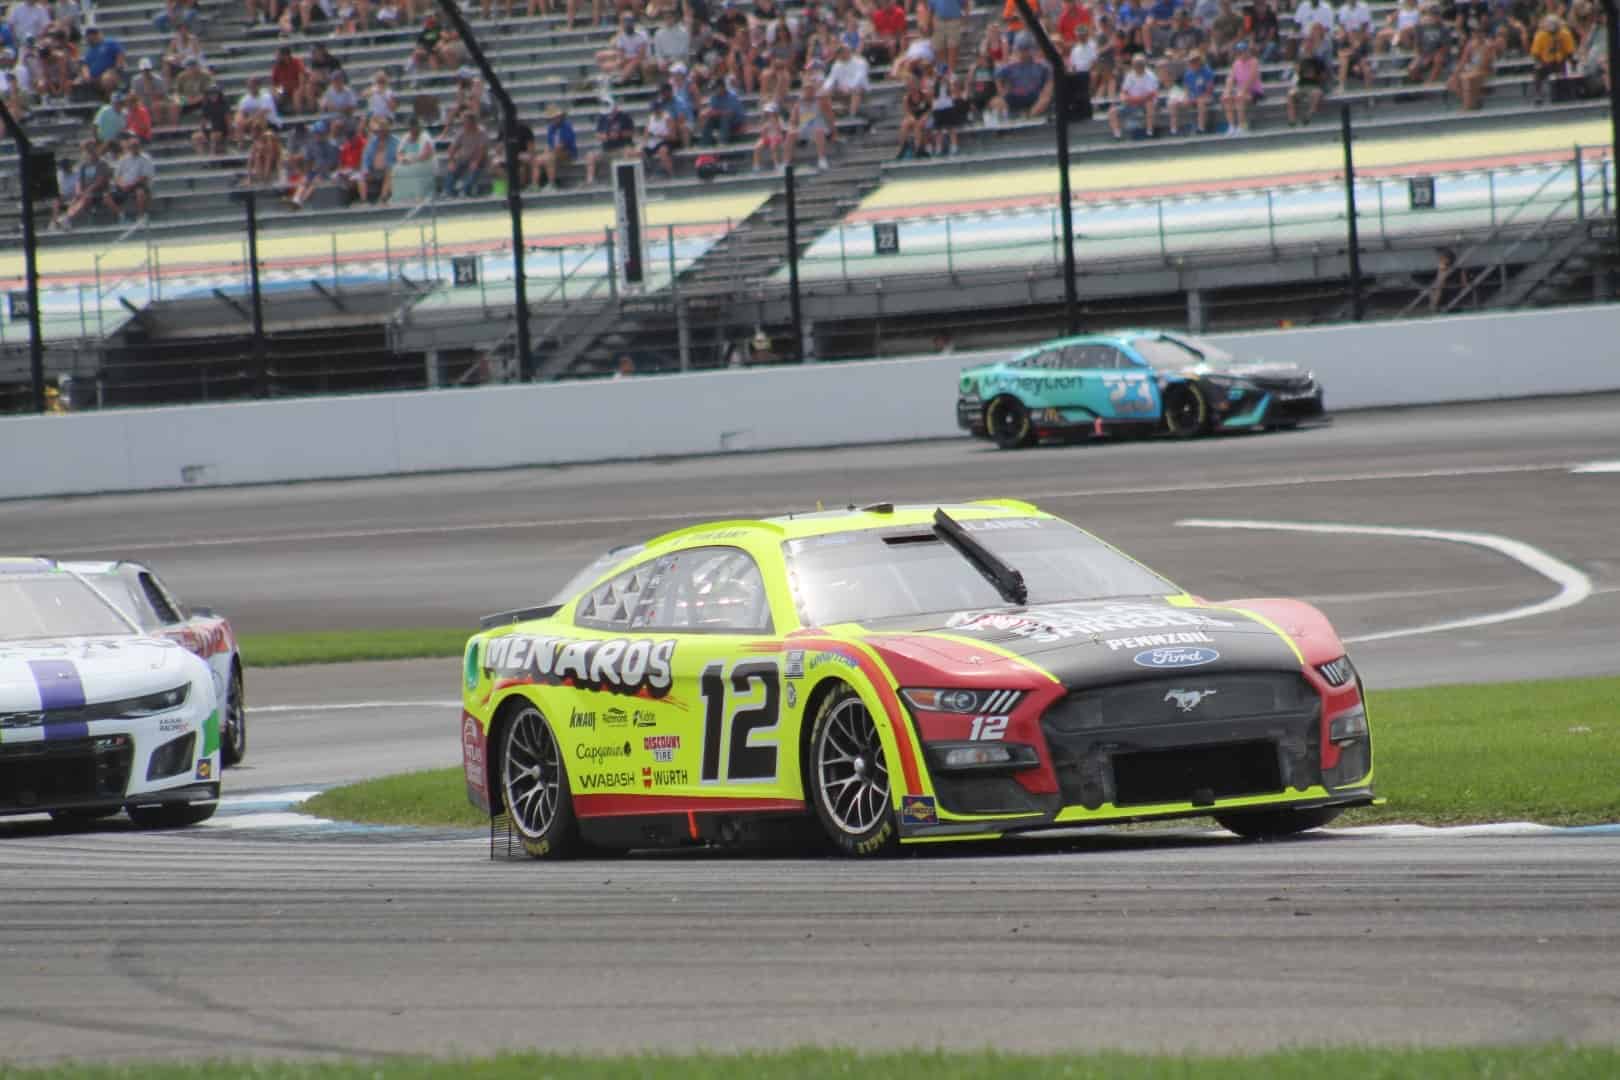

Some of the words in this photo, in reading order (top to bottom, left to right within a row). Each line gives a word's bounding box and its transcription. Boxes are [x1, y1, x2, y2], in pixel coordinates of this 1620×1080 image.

[1105, 631, 1215, 650] PENNZOIL
[485, 636, 678, 692] MENARDS
[1152, 648, 1203, 664] Ford
[699, 658, 780, 783] 12
[969, 716, 1008, 740] 12
[579, 772, 635, 789] WABASH
